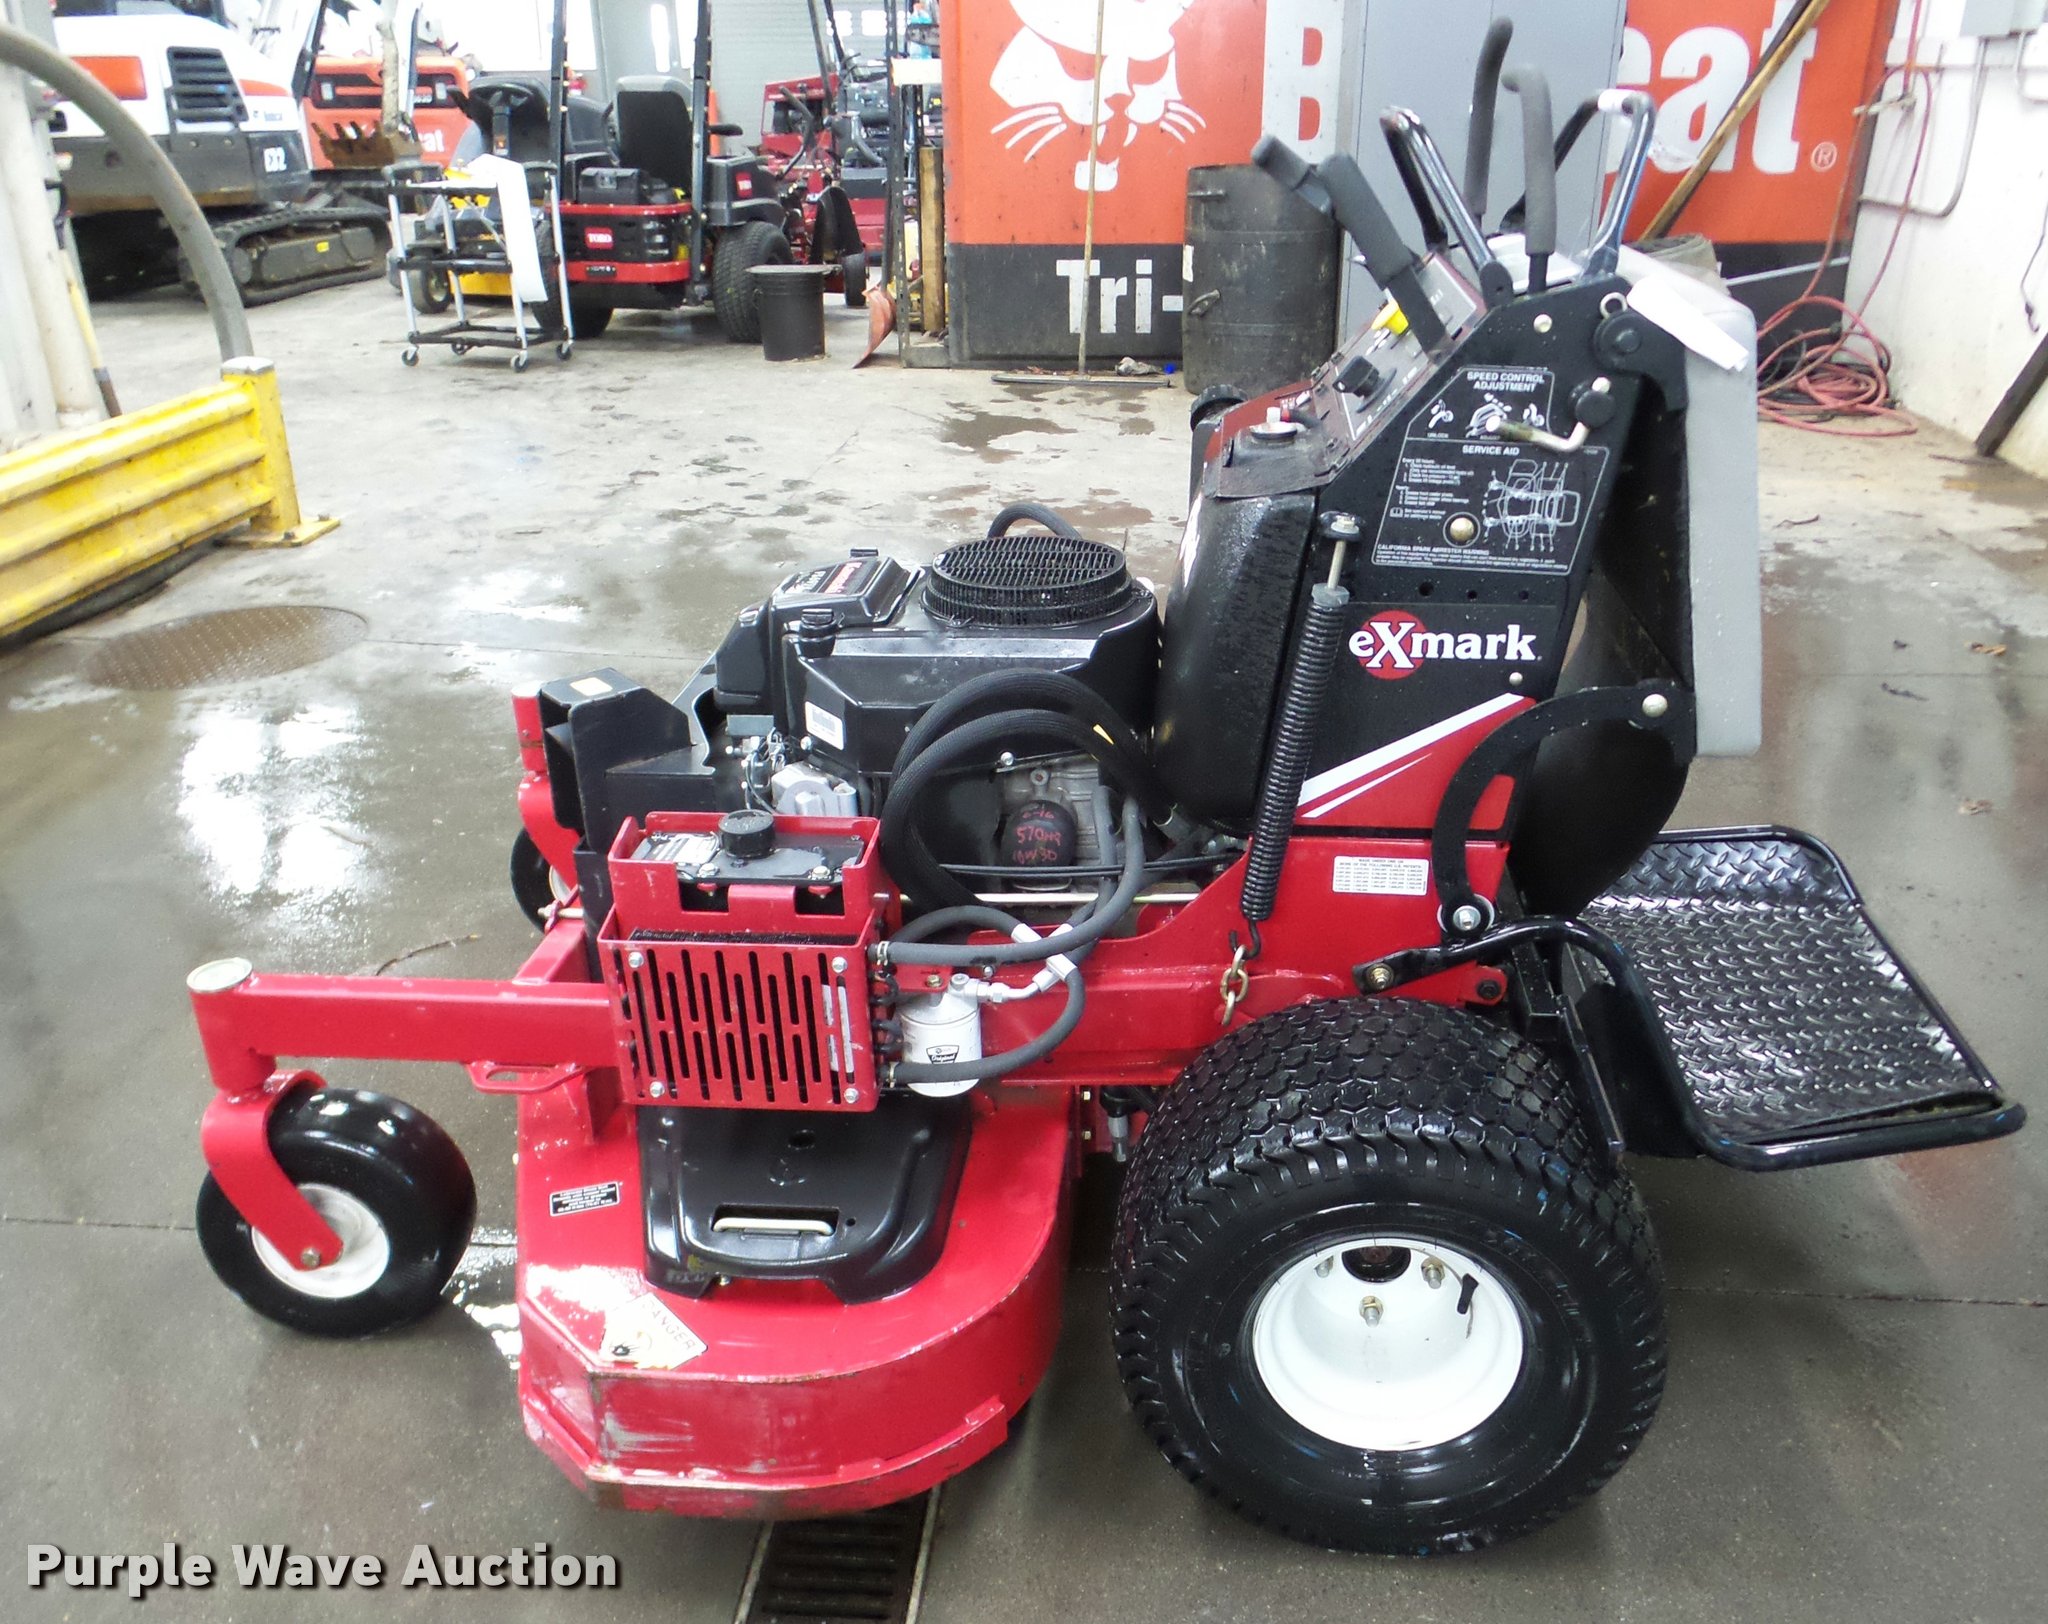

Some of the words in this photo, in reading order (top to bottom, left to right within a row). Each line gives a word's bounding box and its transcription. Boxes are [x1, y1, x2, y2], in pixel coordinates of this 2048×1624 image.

[1467, 371, 1498, 381] SPEED
[1500, 372, 1545, 384] CONTROL
[1473, 381, 1537, 393] ADJUSTMENT
[1462, 445, 1502, 455] SERVICE
[1503, 446, 1520, 455] AID
